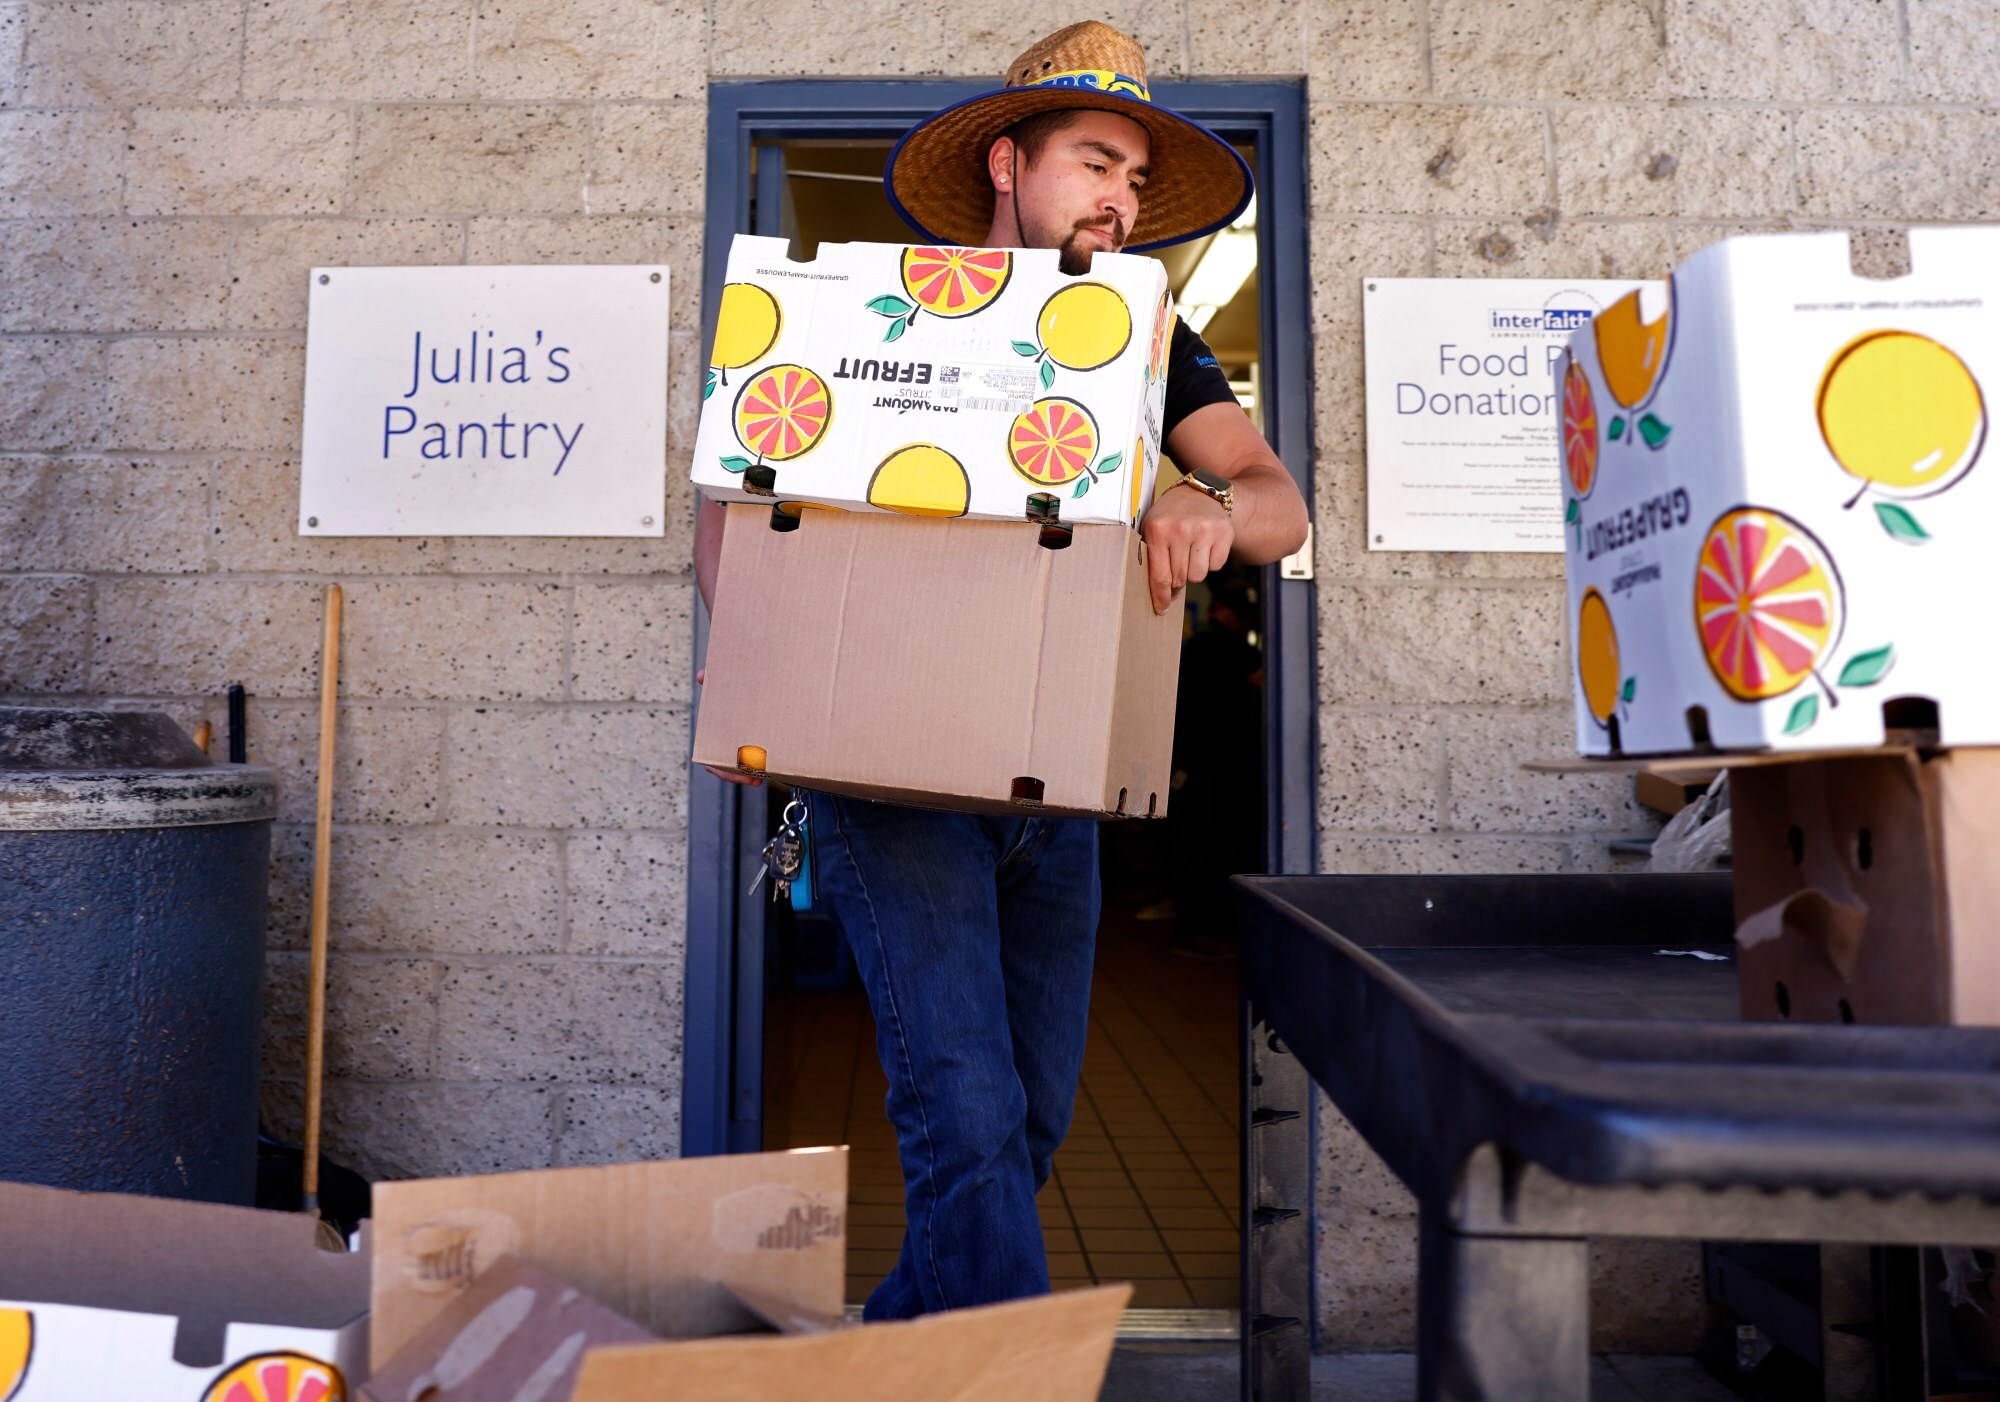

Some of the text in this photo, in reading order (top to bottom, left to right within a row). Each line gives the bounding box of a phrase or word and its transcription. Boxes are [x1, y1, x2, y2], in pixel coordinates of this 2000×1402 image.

[756, 268, 850, 282] GRAPEFRUIT/PAMPLEMOUSSE
[403, 330, 570, 398] Julia's
[833, 357, 932, 385] EFRUIT
[1439, 344, 1528, 376] Food
[383, 405, 584, 476] Pantry
[1586, 486, 1691, 562] GRAPEFRUIT
